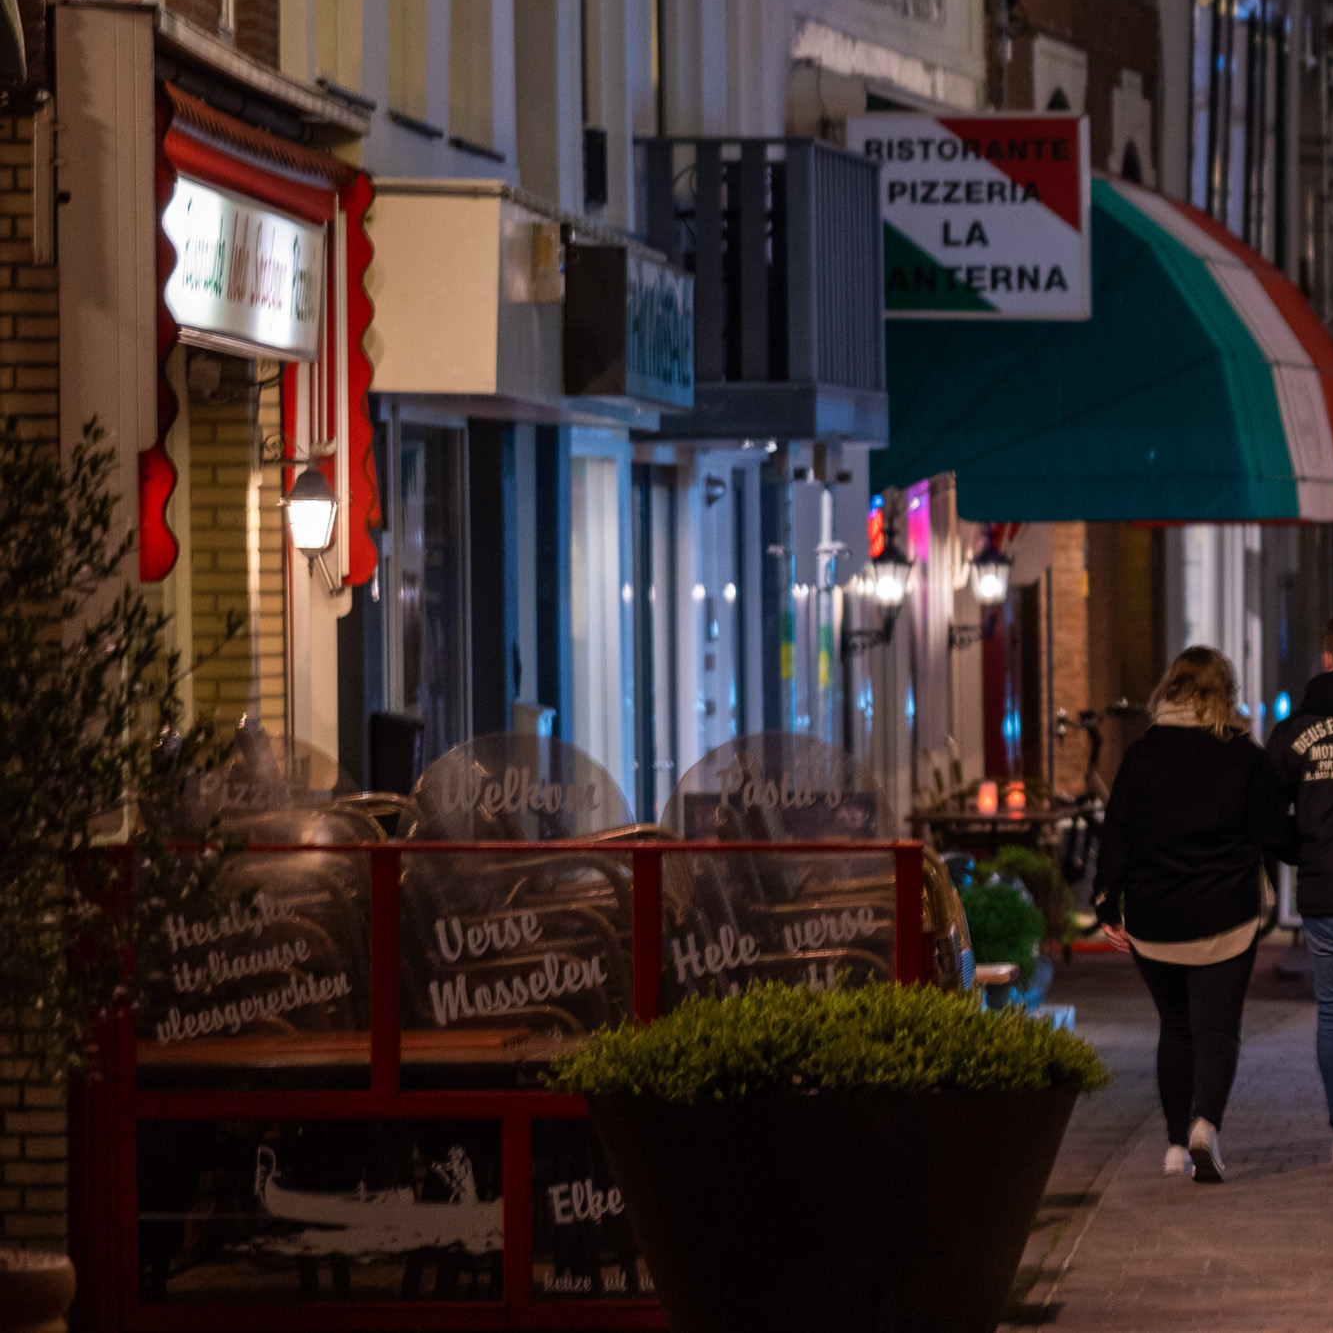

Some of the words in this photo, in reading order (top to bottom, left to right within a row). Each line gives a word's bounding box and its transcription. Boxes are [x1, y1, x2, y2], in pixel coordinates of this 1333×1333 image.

[865, 137, 1070, 163] RISTORANTE
[887, 180, 1042, 205] PIZZERIA
[941, 220, 990, 248] LA
[887, 264, 1069, 293] ANTERNA
[1291, 720, 1327, 755] DEUS
[441, 766, 600, 816] Welkom
[434, 910, 543, 964] Verse
[671, 924, 761, 984] Hele
[783, 906, 878, 953] verse
[156, 971, 352, 1046] vleesgerechten
[429, 953, 608, 1027] Mosselen
[547, 1178, 625, 1225] Elke
